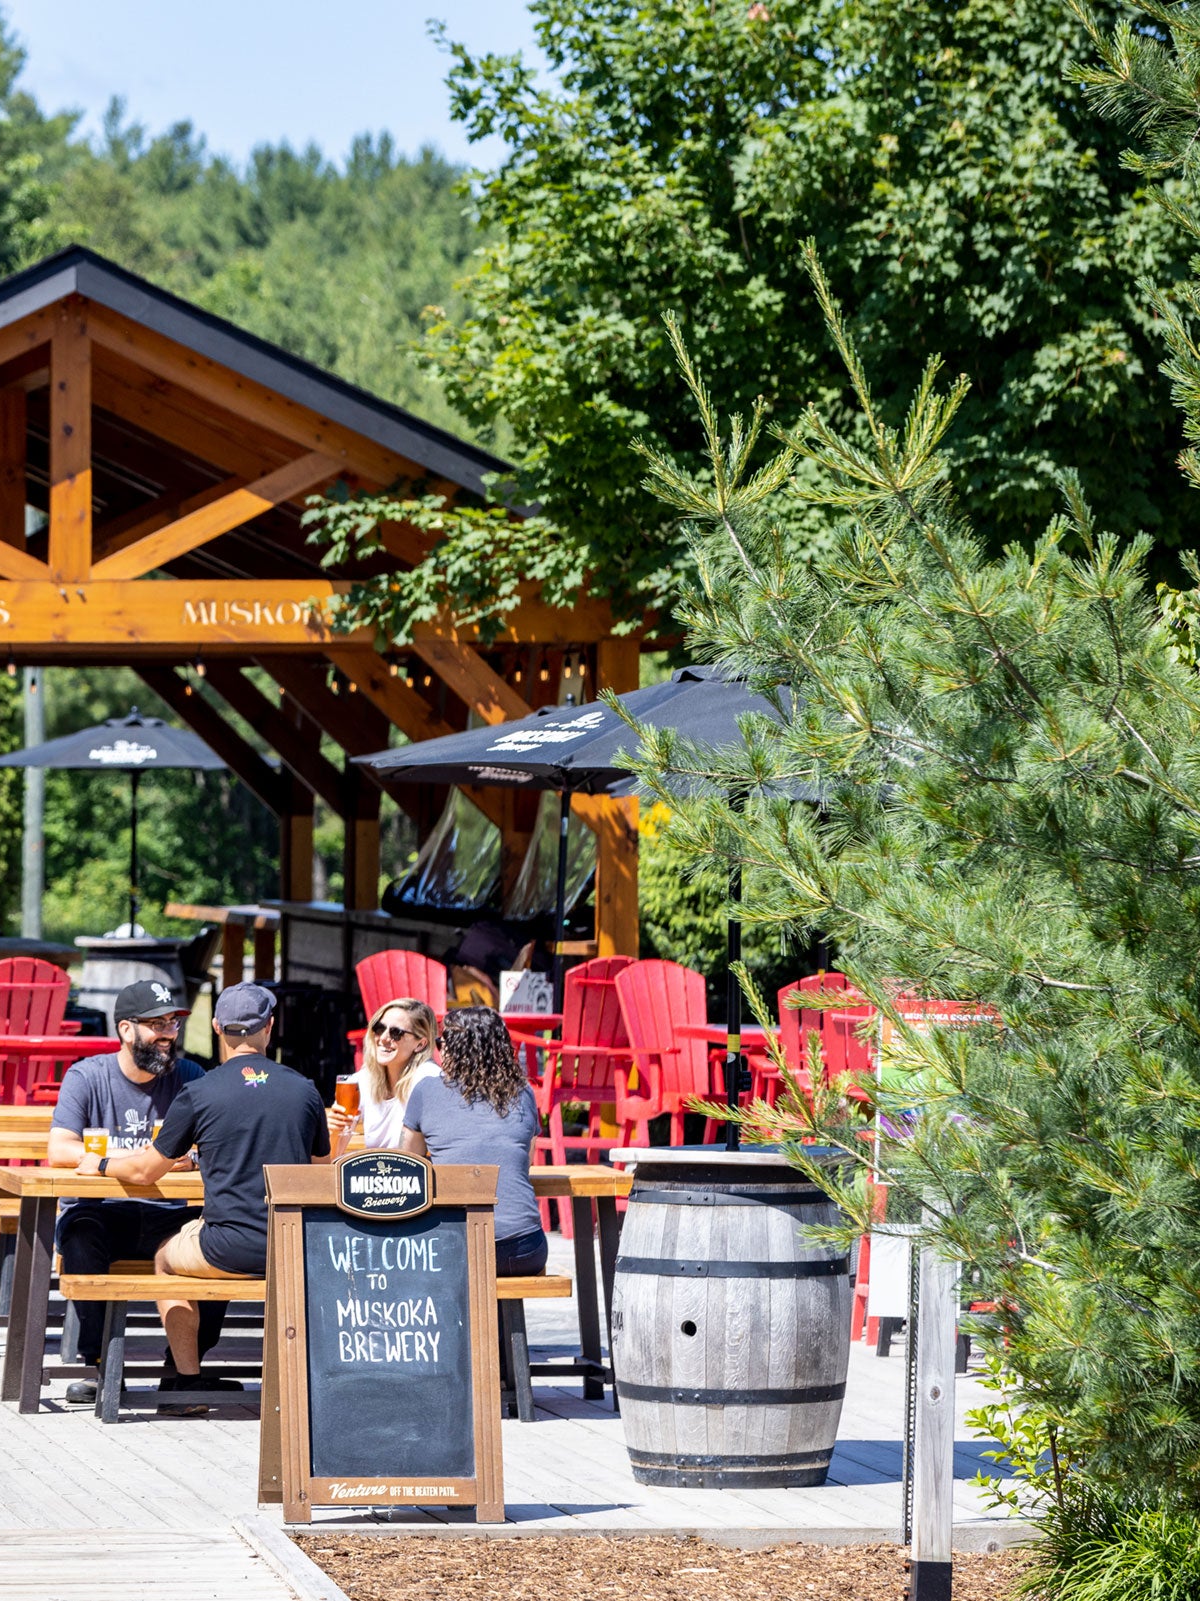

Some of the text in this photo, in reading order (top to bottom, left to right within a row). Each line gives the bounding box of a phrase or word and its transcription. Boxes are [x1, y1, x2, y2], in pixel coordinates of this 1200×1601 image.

[108, 1136, 151, 1150] MUSKO
[350, 1176, 421, 1195] MUSKOKA
[362, 1195, 408, 1208] Brewery
[328, 1234, 442, 1273] WELCOME
[366, 1273, 388, 1291] TO
[336, 1296, 438, 1328] MUSKOKA
[338, 1331, 440, 1364] BREWERY
[328, 1482, 389, 1499] Venture
[389, 1486, 402, 1497] OFF
[402, 1486, 415, 1497] THE
[415, 1486, 438, 1497] BEATEN
